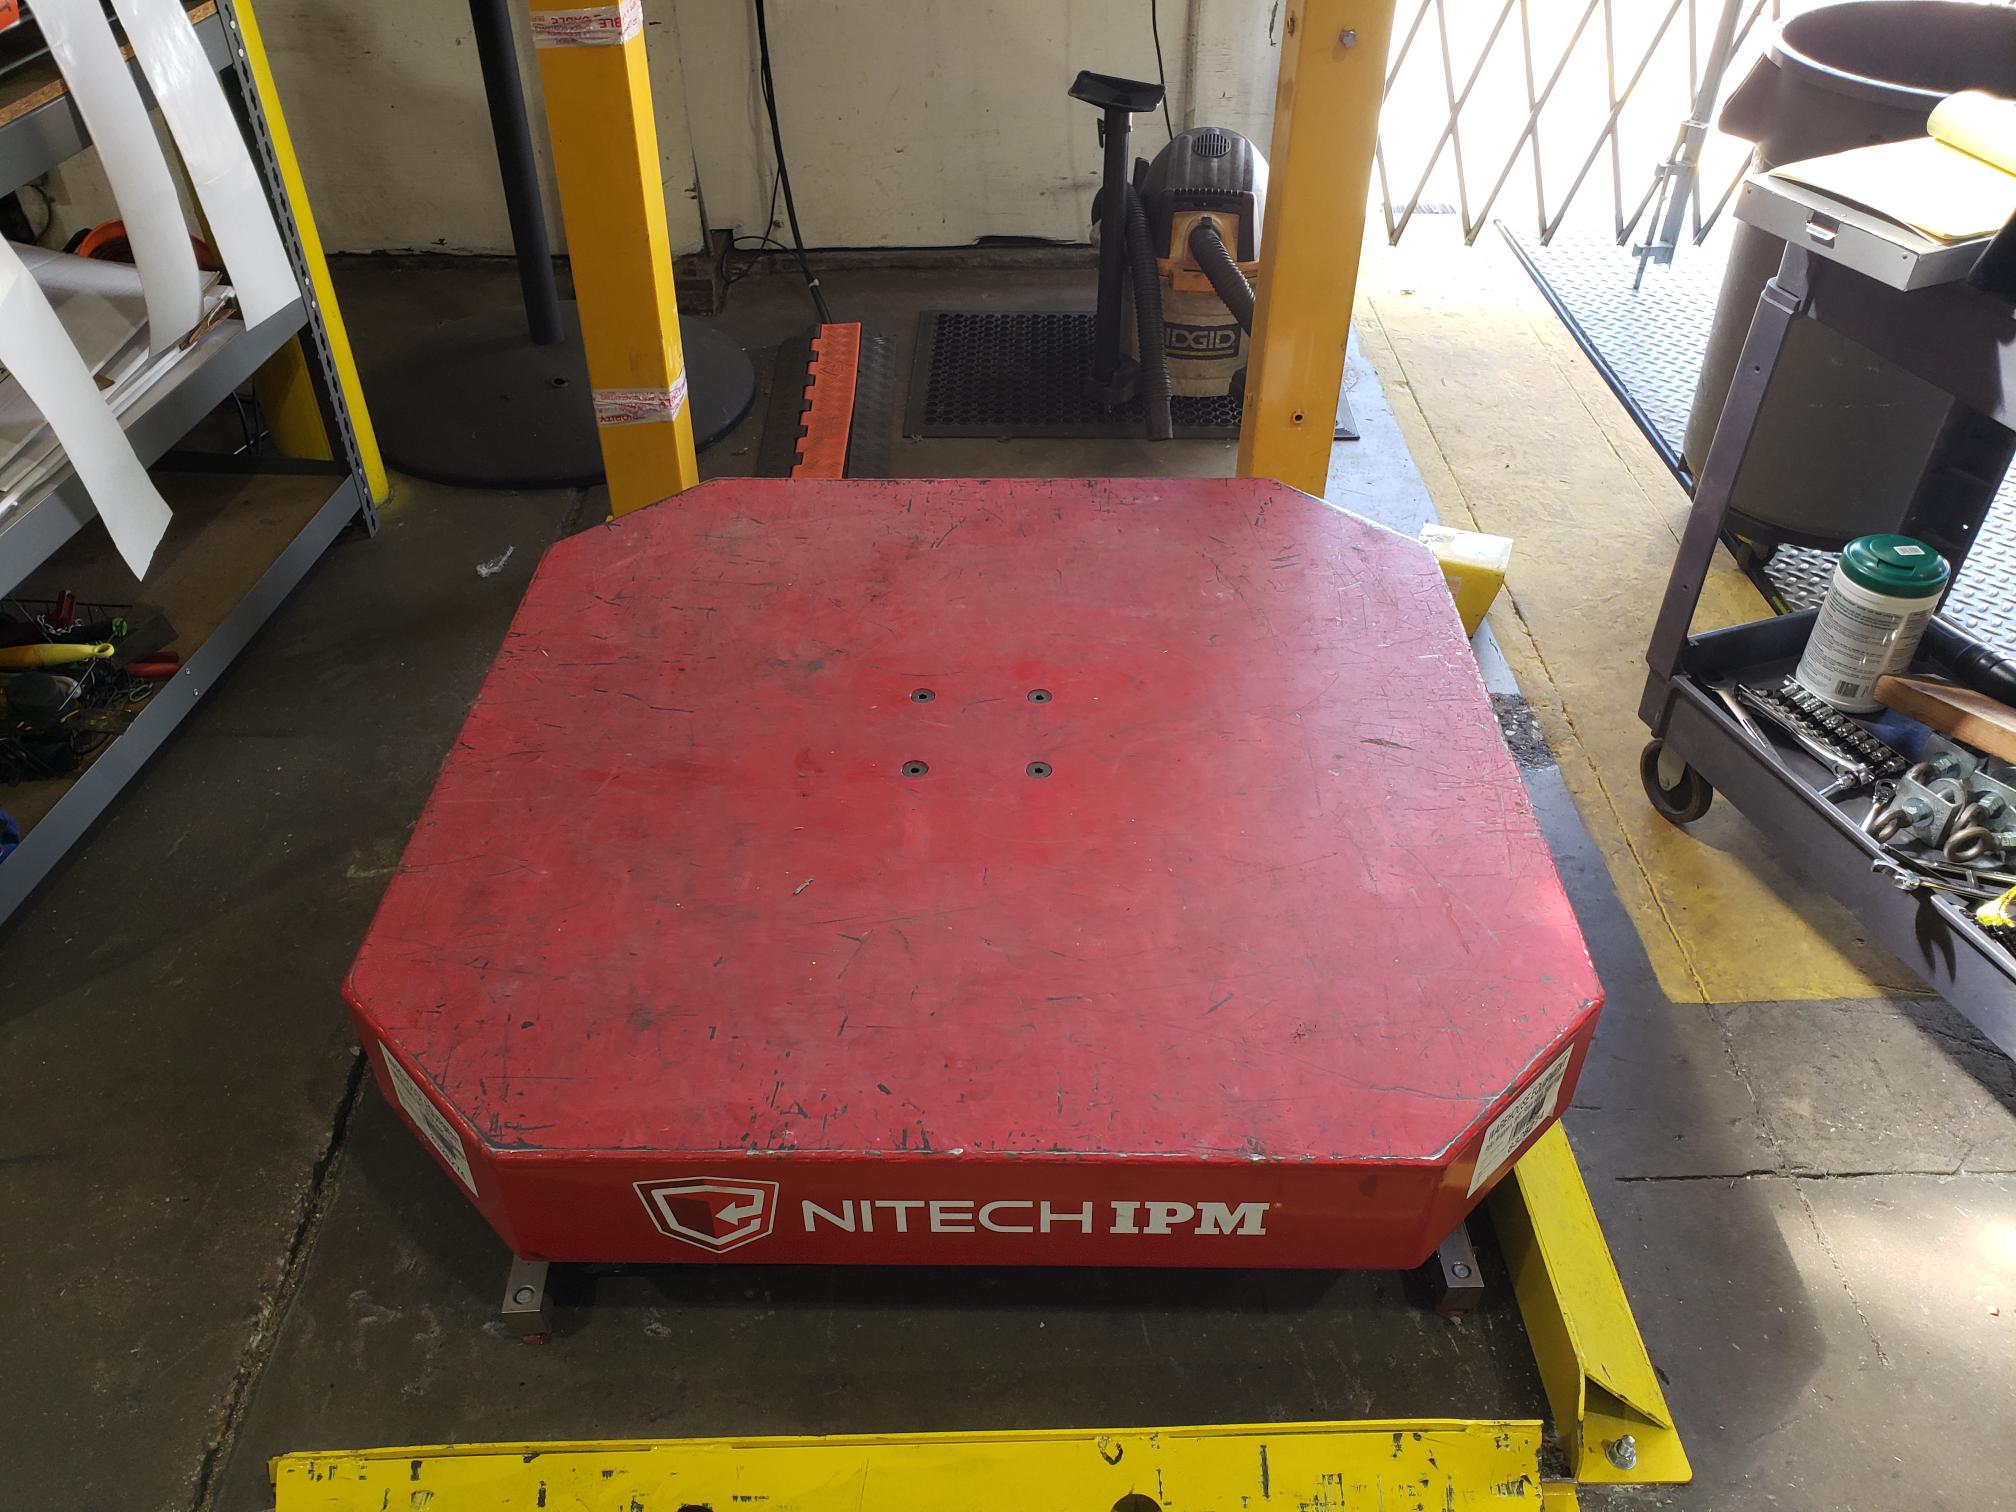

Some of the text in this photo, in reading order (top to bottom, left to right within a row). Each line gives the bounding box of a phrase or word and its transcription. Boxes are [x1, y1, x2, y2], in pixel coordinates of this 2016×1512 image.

[1165, 327, 1236, 349] IDGID
[801, 1199, 1271, 1236] NITECH IPM
